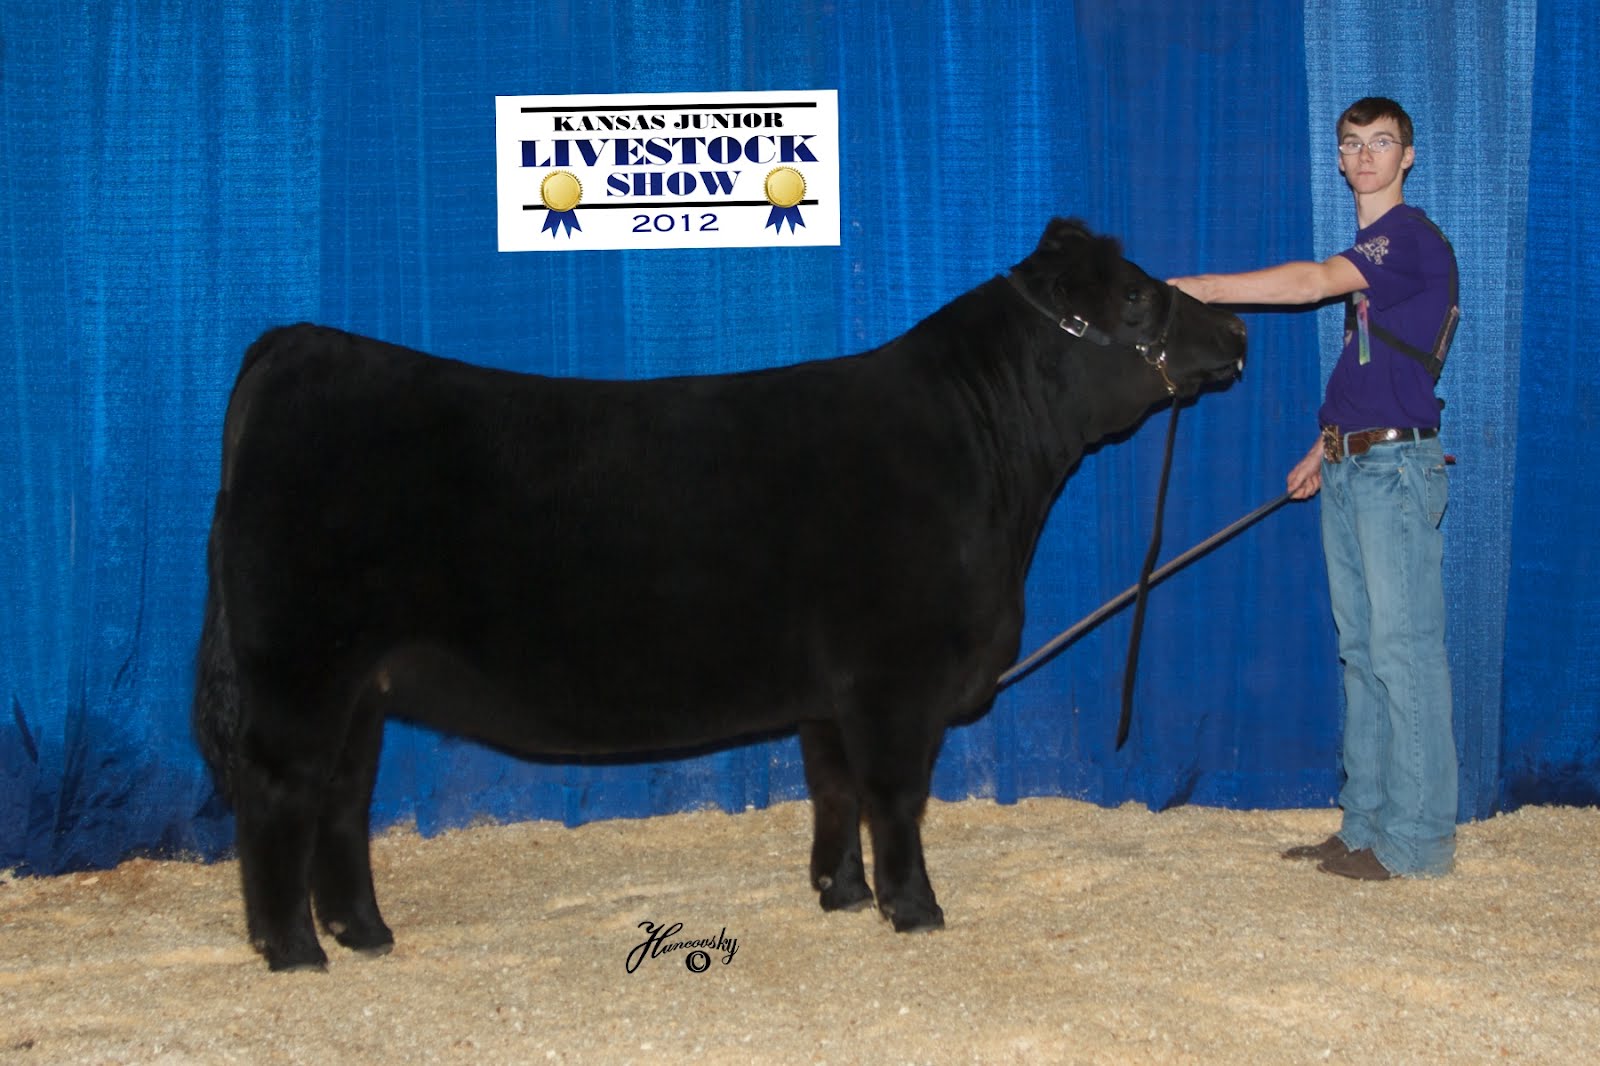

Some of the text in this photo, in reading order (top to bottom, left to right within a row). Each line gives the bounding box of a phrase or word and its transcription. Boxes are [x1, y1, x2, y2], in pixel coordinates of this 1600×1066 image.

[553, 112, 784, 132] KANSAS JUNIOR
[518, 135, 819, 167] LIVESTOCK
[606, 171, 742, 197] SHOW
[632, 213, 719, 233] 2012
